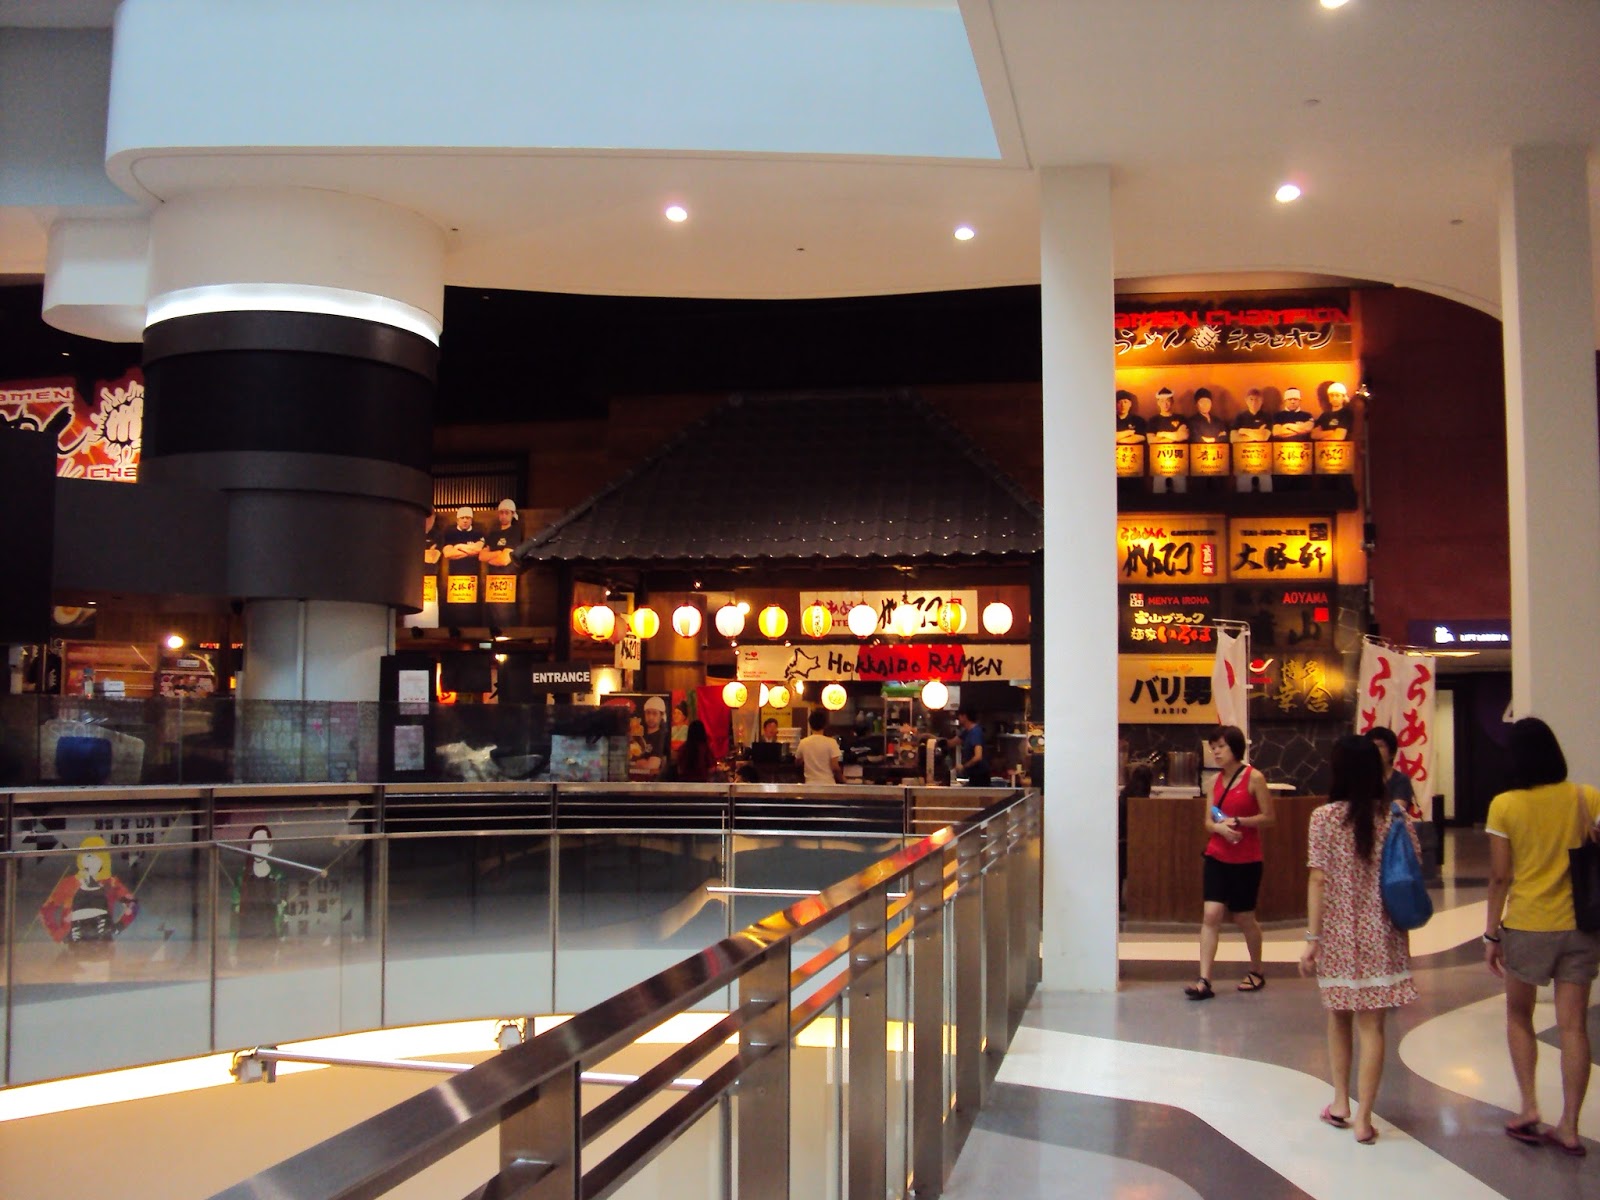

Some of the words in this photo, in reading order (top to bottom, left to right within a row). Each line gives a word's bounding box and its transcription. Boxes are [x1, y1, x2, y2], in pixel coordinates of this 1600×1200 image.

[1115, 310, 1199, 328] AMEN
[1282, 591, 1328, 604] AOYAMA
[927, 652, 1003, 677] RAMEN
[532, 671, 590, 684] ENTRANCE
